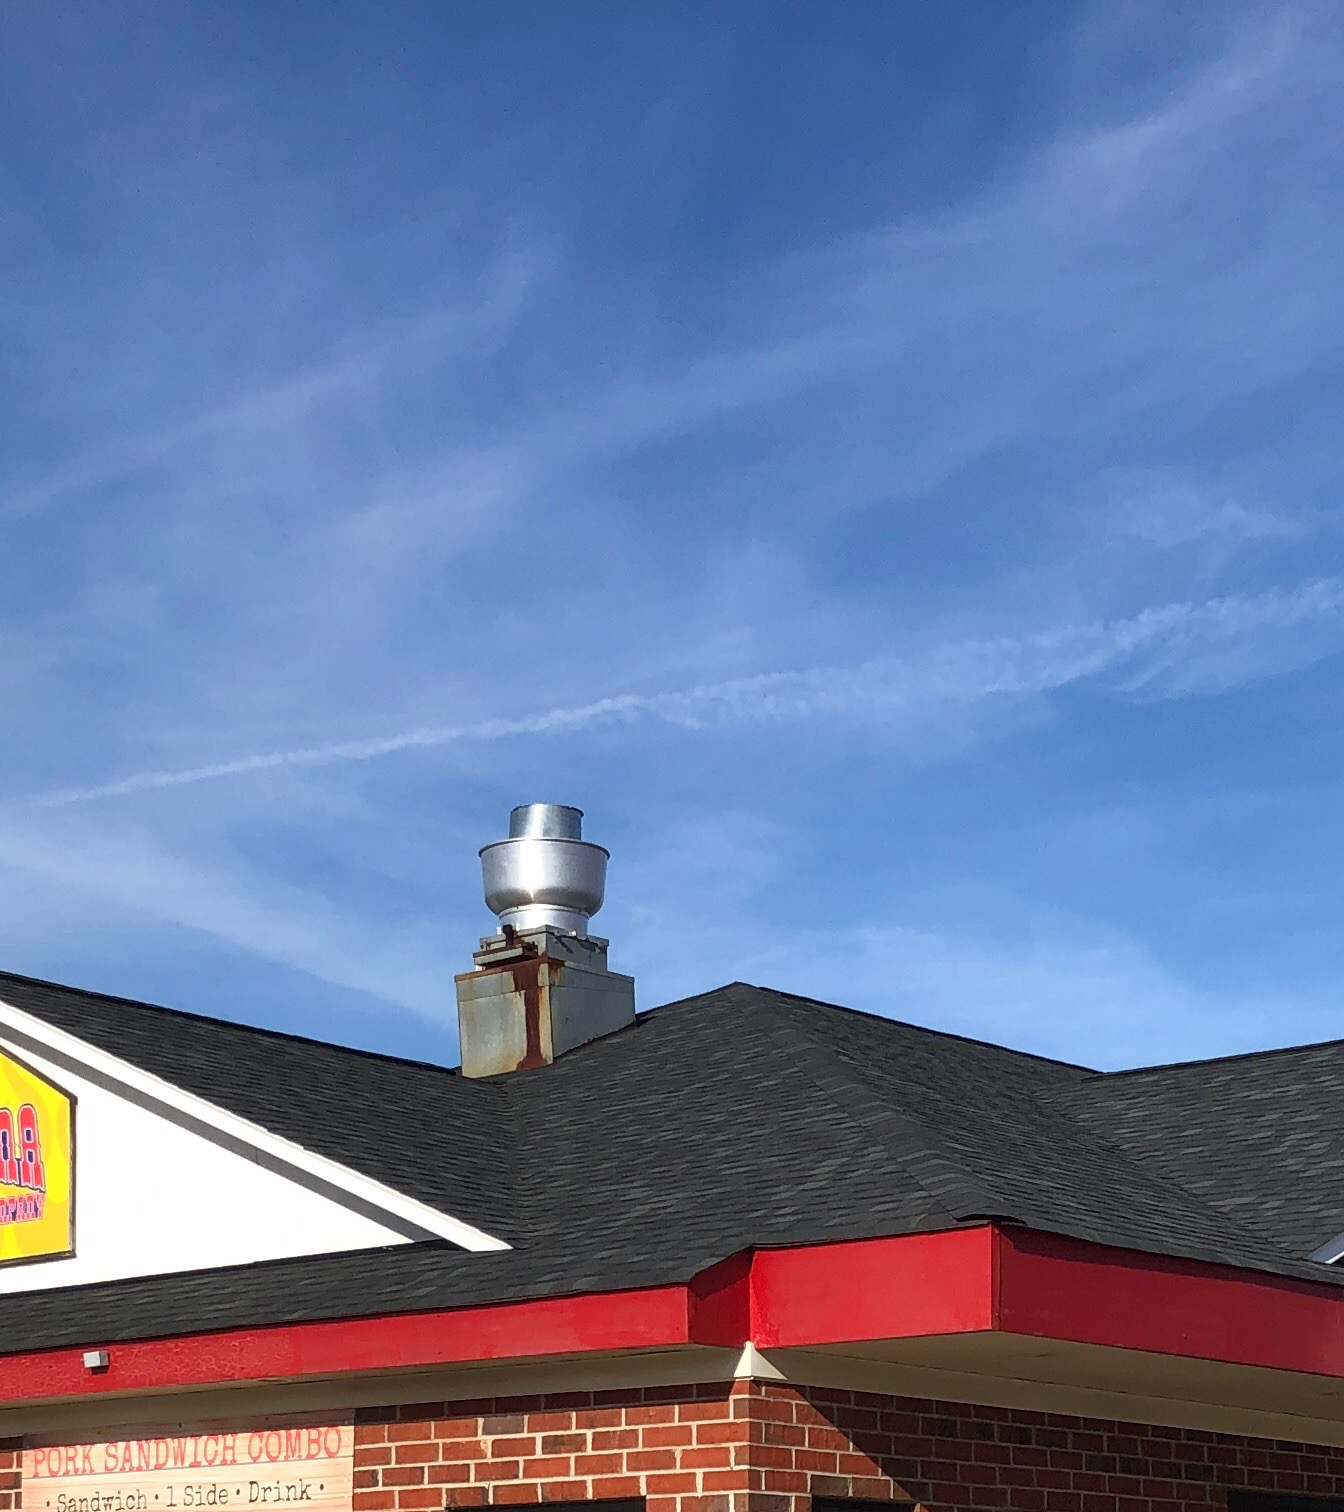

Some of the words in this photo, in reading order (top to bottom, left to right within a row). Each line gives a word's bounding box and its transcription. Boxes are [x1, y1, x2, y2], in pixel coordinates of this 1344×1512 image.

[32, 1445, 95, 1478] PORK
[104, 1433, 237, 1473] SANDWICH
[248, 1426, 342, 1462] COMBO
[166, 1486, 177, 1507] 1
[183, 1483, 229, 1506] Side
[248, 1478, 312, 1503] Drink
